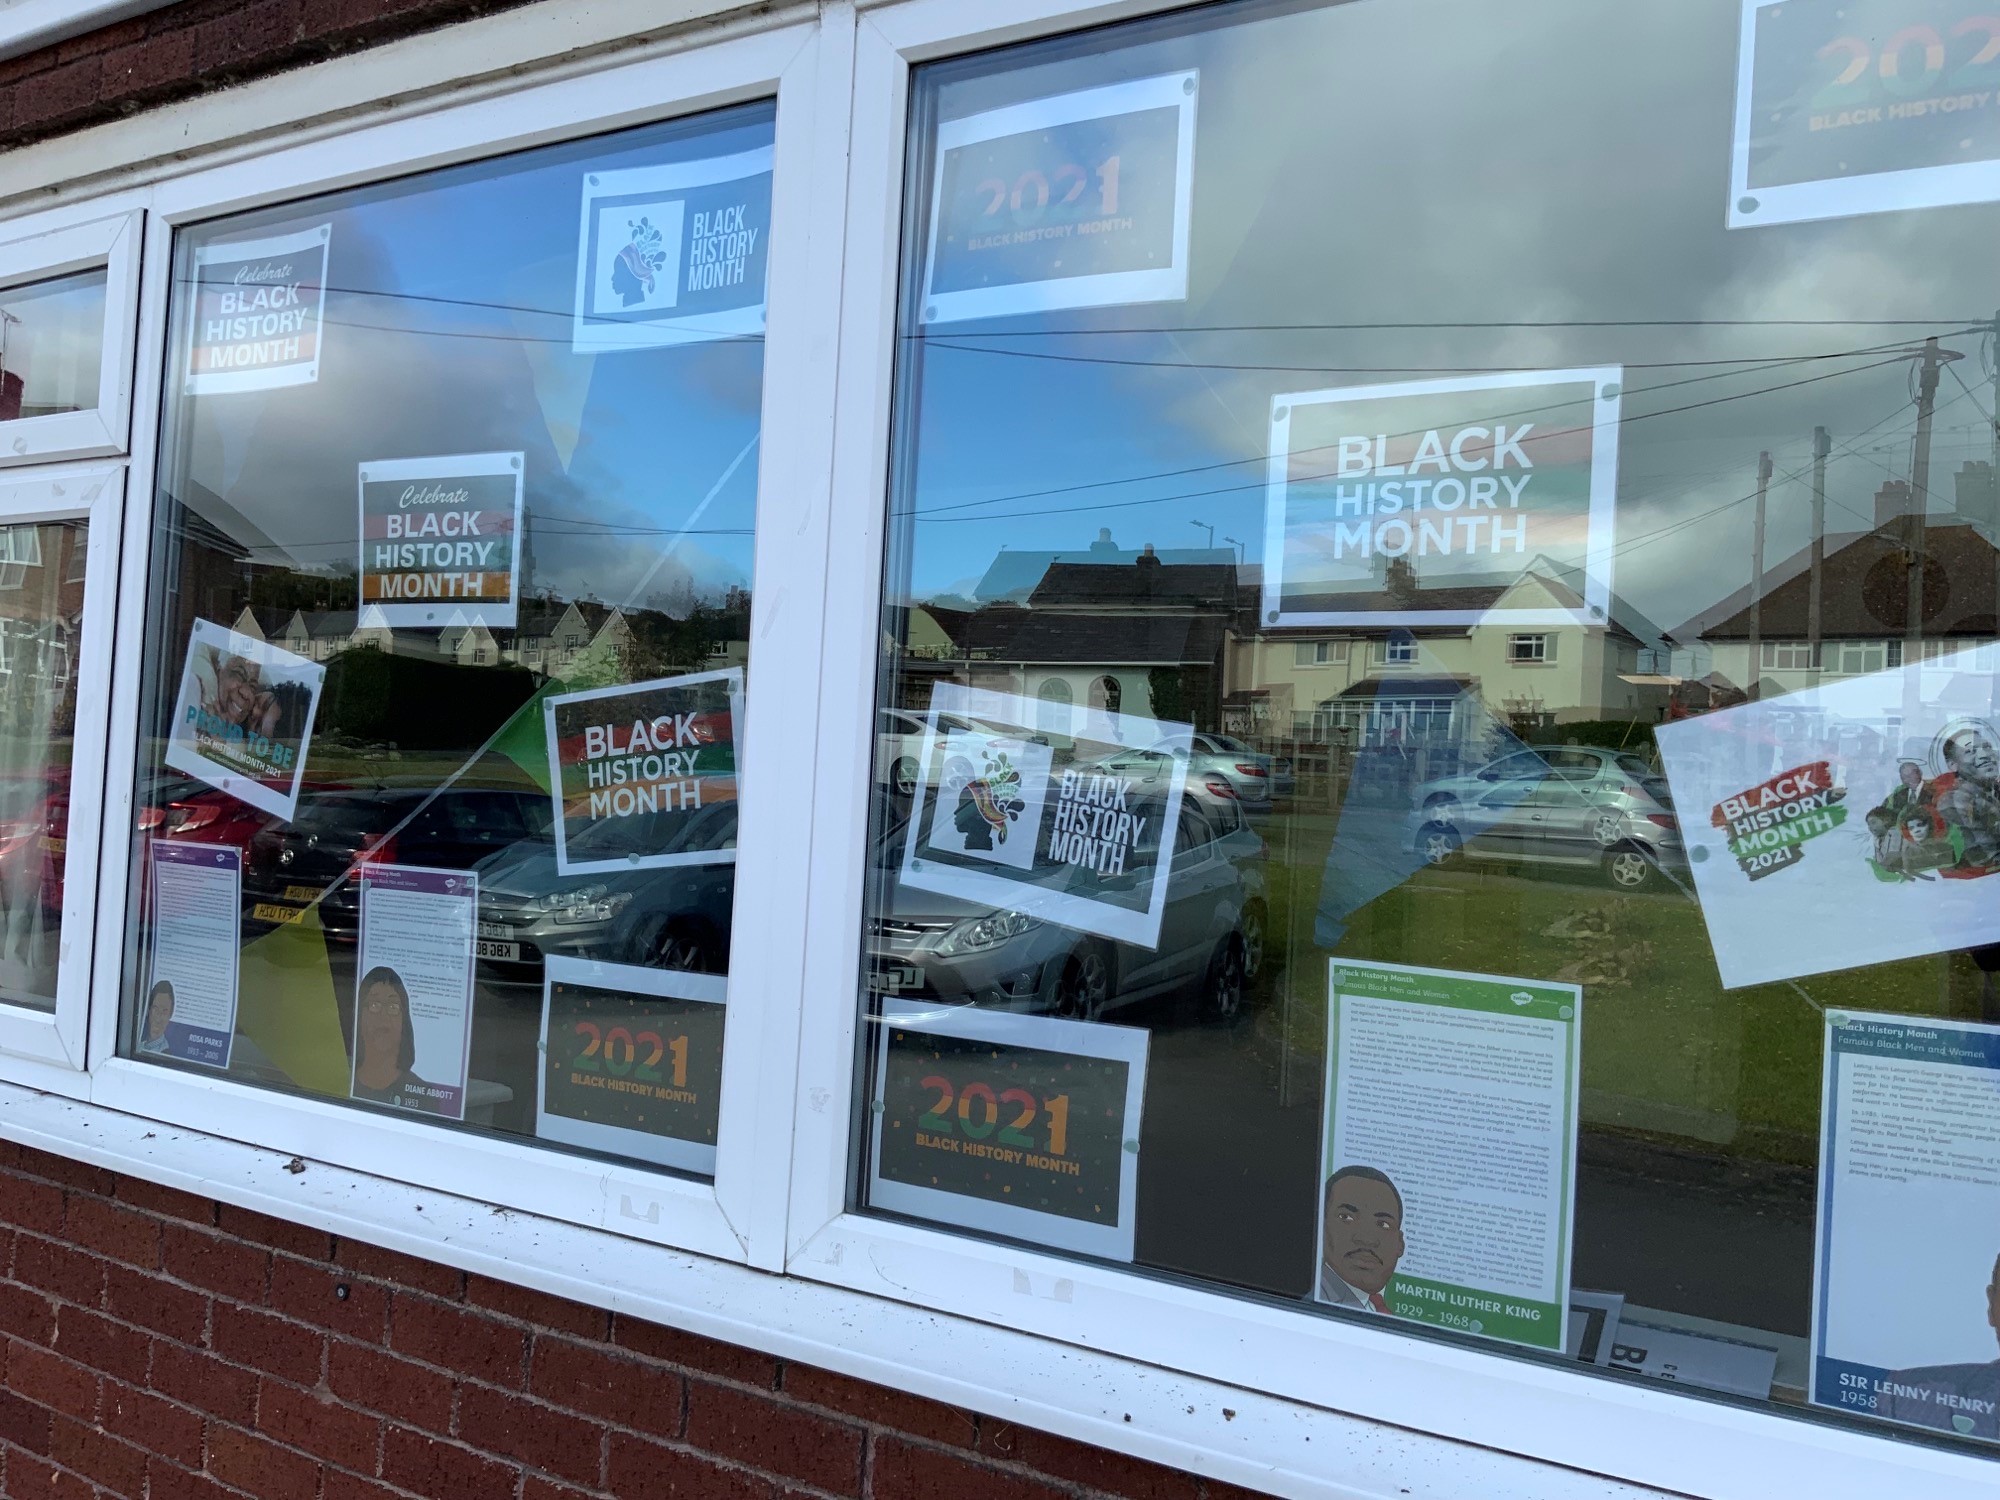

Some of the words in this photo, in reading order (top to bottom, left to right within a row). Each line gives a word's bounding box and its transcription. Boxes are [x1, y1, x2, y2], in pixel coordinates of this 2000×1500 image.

[1809, 106, 1882, 131] BLACK
[1888, 91, 1990, 119] HISTORY
[973, 156, 1120, 231] 2021
[692, 204, 746, 240] BLACK
[968, 232, 1011, 250] BLACK
[1014, 224, 1074, 244] HISTORY
[1077, 217, 1133, 235] MONTH
[690, 227, 758, 266] HISTORY
[234, 262, 293, 286] Celebrate
[687, 257, 745, 292] MONTH
[220, 282, 300, 314] BLACK
[206, 307, 308, 341] HISTORY
[210, 336, 299, 368] MONTH
[1337, 423, 1535, 479] BLACK
[399, 484, 469, 509] Celebrate
[1335, 474, 1532, 517] HISTORY
[387, 510, 482, 539] BLACK
[1333, 514, 1527, 559] MONTH
[375, 541, 494, 569] HISTORY
[380, 572, 483, 598] MONTH
[186, 705, 243, 744] PROUD
[247, 731, 269, 758] TO
[271, 742, 293, 769] BE
[585, 712, 700, 760] BLACK
[240, 753, 266, 771] MONTH
[265, 764, 281, 778] 2021
[588, 750, 699, 788] HISTORY
[590, 779, 702, 821] MONTH
[1060, 768, 1132, 811] BLACK
[1719, 770, 1819, 822] BLACK
[1054, 800, 1147, 848] HISTORY
[1732, 790, 1830, 837] HISTORY
[1737, 811, 1835, 855] MONTH
[1048, 829, 1126, 876] MONTH
[1746, 844, 1792, 873] 2021
[1339, 969, 1358, 977] Black
[1361, 971, 1388, 982] History
[1391, 974, 1414, 984] Month
[1368, 983, 1387, 992] Black
[1390, 985, 1404, 994] Men
[1407, 988, 1420, 996] and
[1838, 1035, 1873, 1047] Famous
[1876, 1039, 1902, 1049] Black
[1905, 1042, 1925, 1053] Men
[1928, 1046, 1946, 1056] and
[1949, 1047, 1985, 1059] Women
[1867, 1025, 1903, 1038] History
[1906, 1029, 1938, 1040] Month
[573, 1022, 688, 1088] 2021
[405, 1084, 426, 1095] DIANE
[426, 1088, 454, 1100] ABBOTT
[405, 1097, 419, 1108] 1953
[571, 1073, 605, 1089] BLACK
[607, 1078, 653, 1097] HISTORY
[655, 1086, 697, 1104] MONTH
[918, 1075, 1069, 1156] 2021
[916, 1132, 960, 1153] BLACK
[962, 1142, 1023, 1165] HISTORY
[1026, 1153, 1080, 1176] MONTH
[1395, 1281, 1446, 1303] MARTIN
[1450, 1293, 1501, 1314] LUTHER
[1505, 1304, 1541, 1321] KING
[1395, 1302, 1423, 1318] 1929
[1440, 1311, 1469, 1328] 1968
[1839, 1373, 1867, 1389] SIR
[1873, 1379, 1930, 1401] LENNY
[1936, 1391, 1995, 1415] HENRY
[1840, 1390, 1878, 1409] 1958
